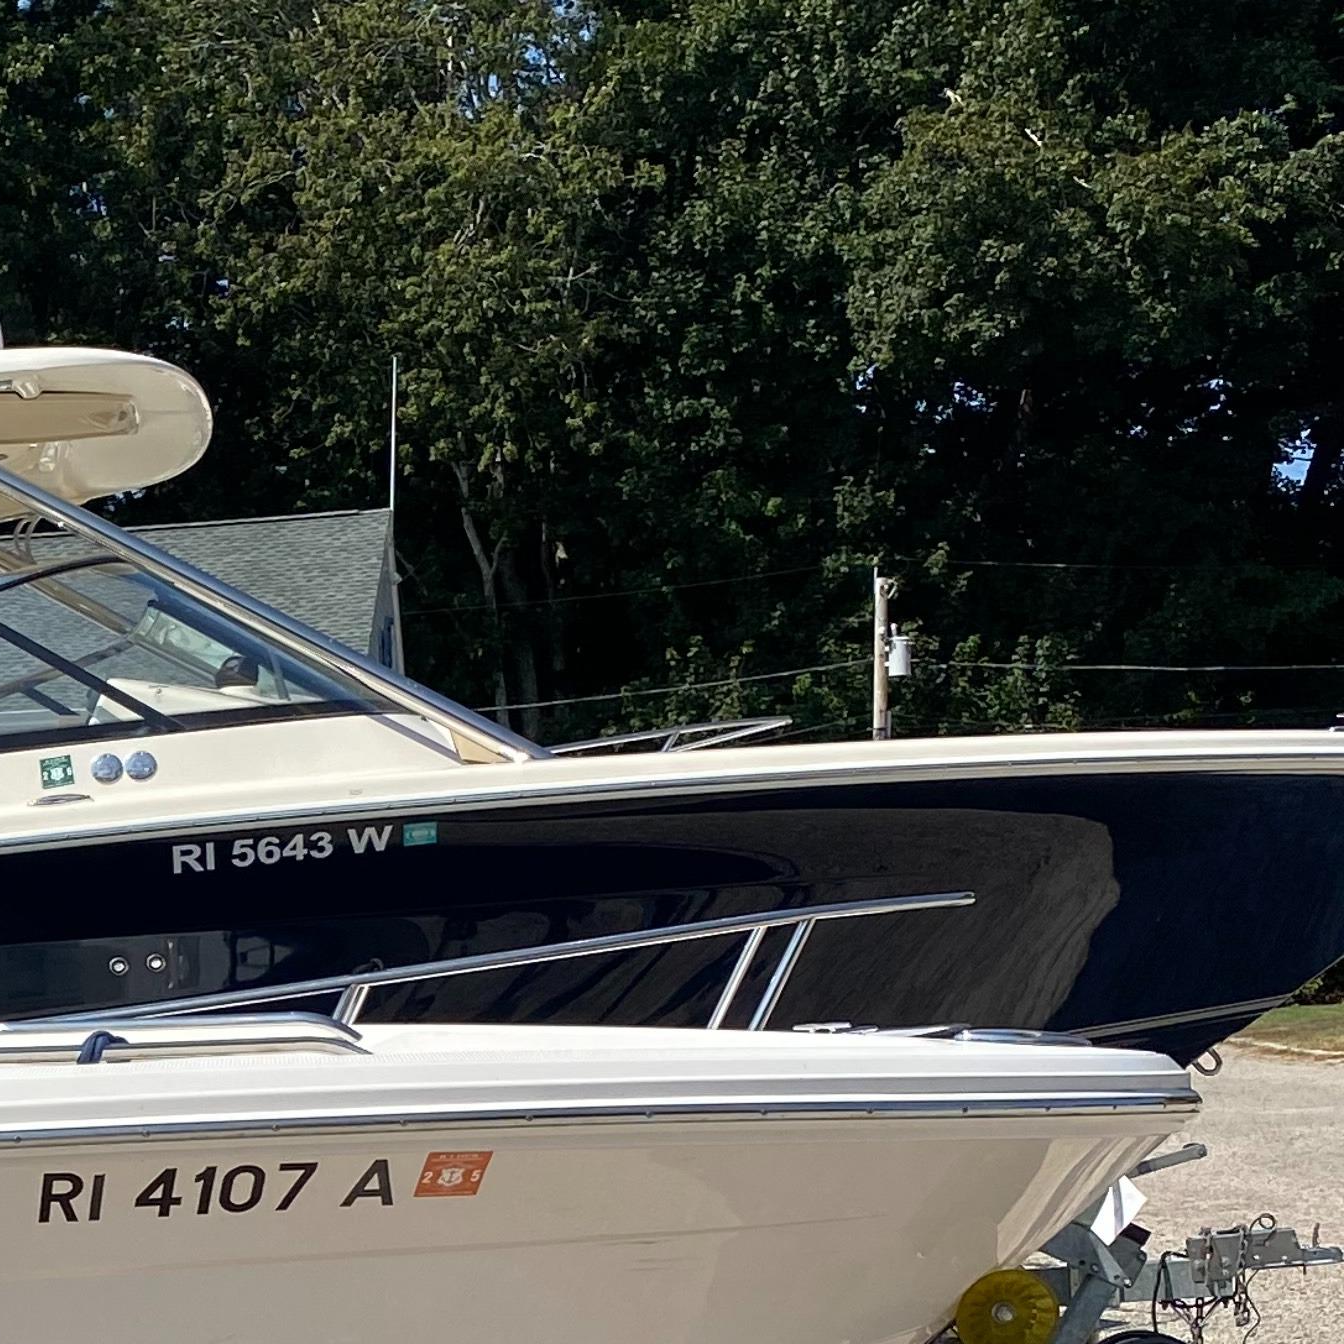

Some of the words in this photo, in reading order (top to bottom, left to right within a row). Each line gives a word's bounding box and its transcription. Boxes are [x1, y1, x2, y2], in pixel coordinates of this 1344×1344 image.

[172, 842, 216, 874] RI
[231, 832, 334, 868] 5643
[347, 825, 394, 854] W
[38, 1172, 106, 1223] RI
[134, 1162, 318, 1217] 4107
[339, 1159, 394, 1207] A
[421, 1171, 434, 1184] 2
[470, 1169, 483, 1182] 5
